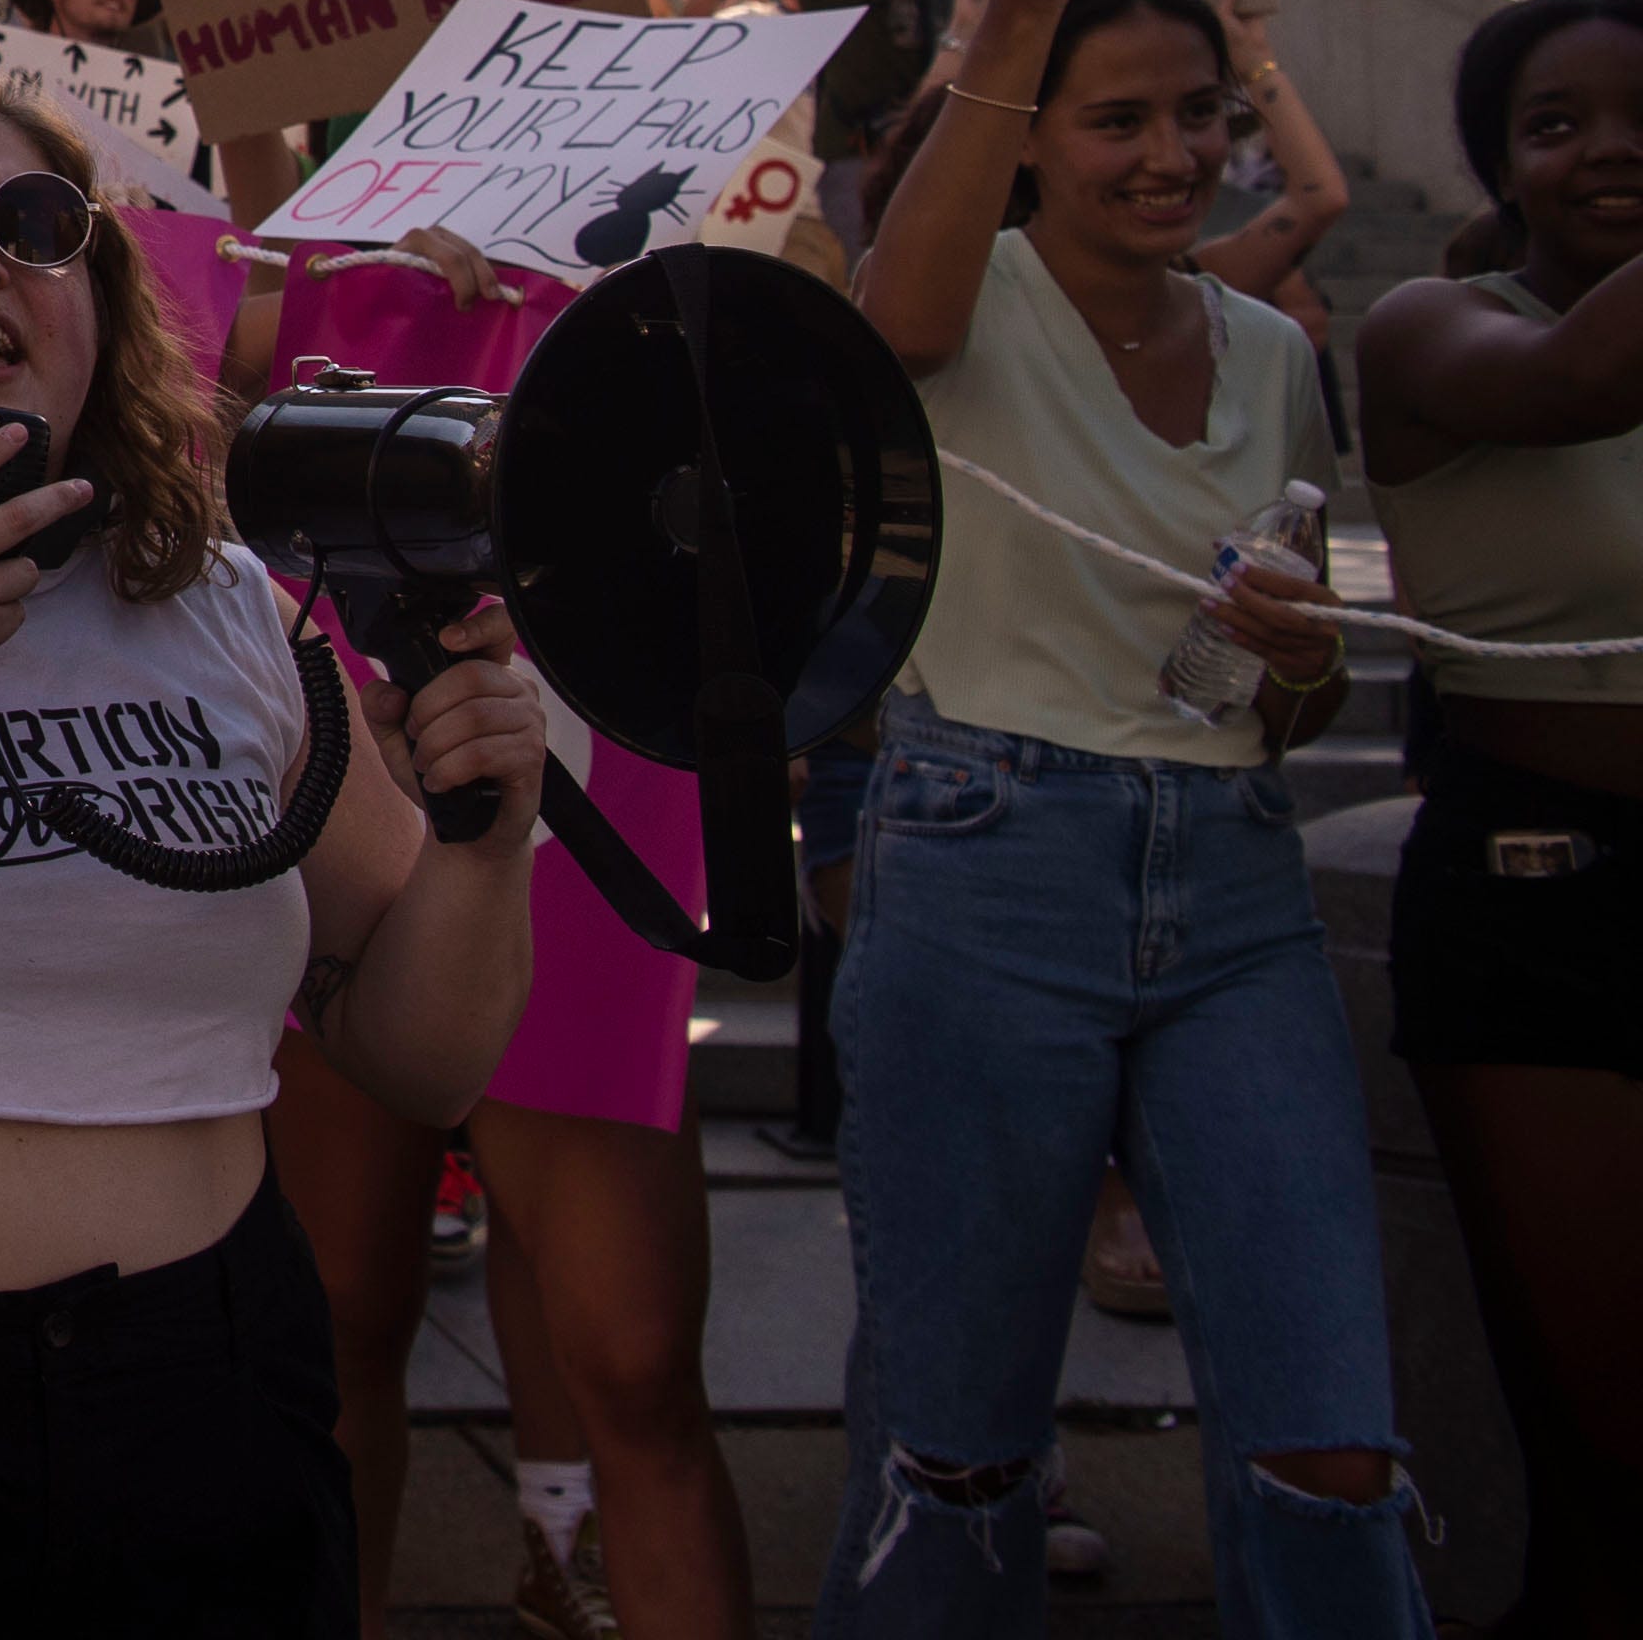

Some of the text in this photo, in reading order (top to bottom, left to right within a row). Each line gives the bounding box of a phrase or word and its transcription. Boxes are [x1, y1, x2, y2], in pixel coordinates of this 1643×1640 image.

[464, 11, 749, 92] KEEP
[373, 90, 783, 156] YOUR LAWS
[291, 159, 611, 237] OFF MY
